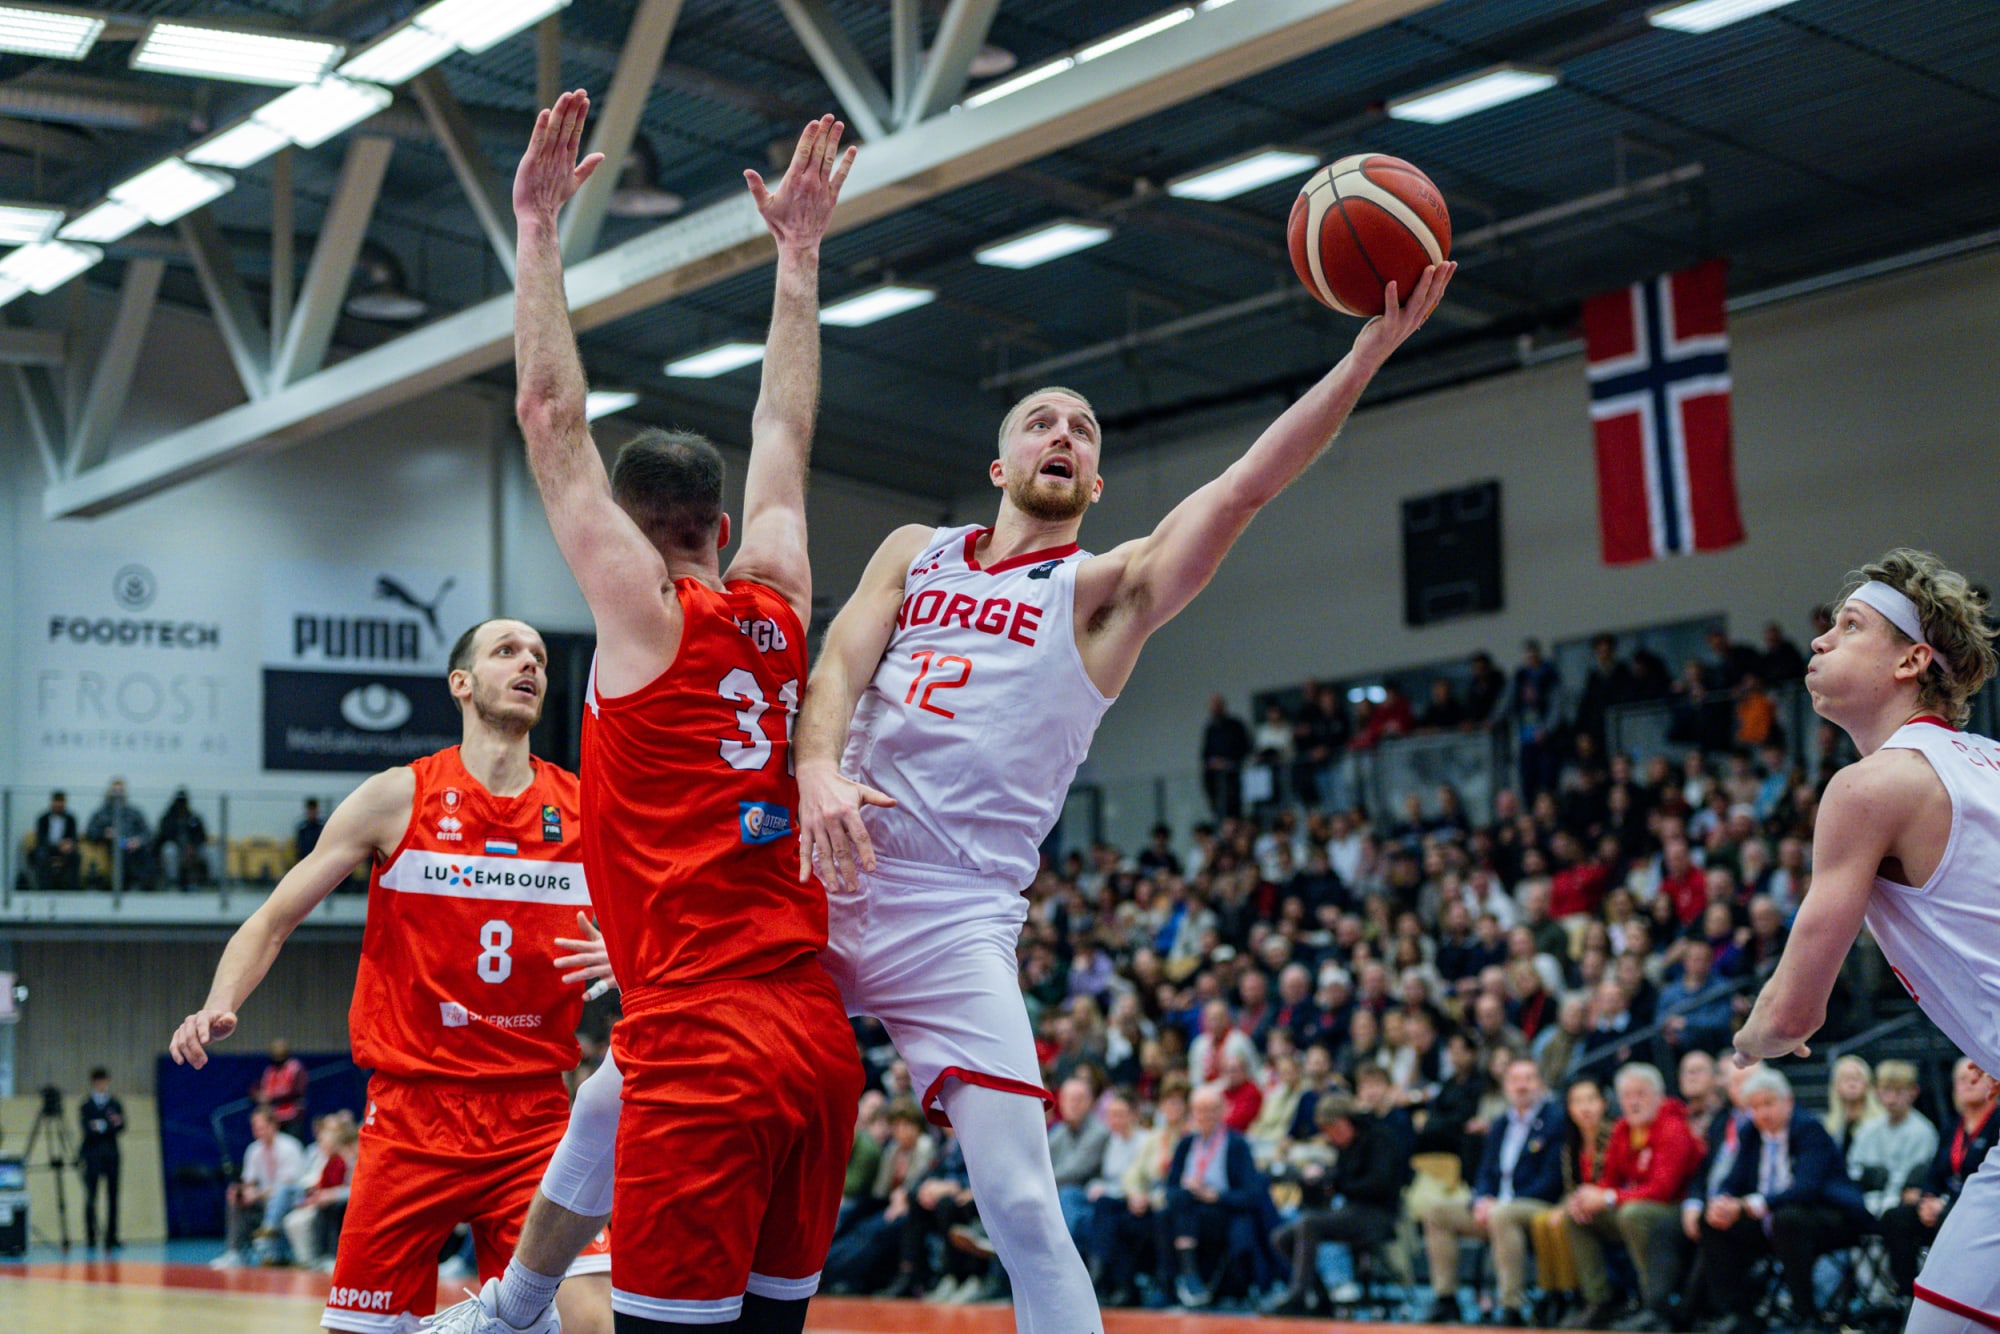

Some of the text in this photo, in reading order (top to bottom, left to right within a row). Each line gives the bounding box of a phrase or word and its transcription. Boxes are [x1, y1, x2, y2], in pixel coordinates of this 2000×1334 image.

[49, 615, 220, 650] FOODTECH
[293, 614, 420, 660] PUMA
[38, 670, 227, 724] FROST
[904, 650, 973, 719] 12
[424, 864, 571, 890] LUXEMBOURG
[476, 919, 513, 984] 8
